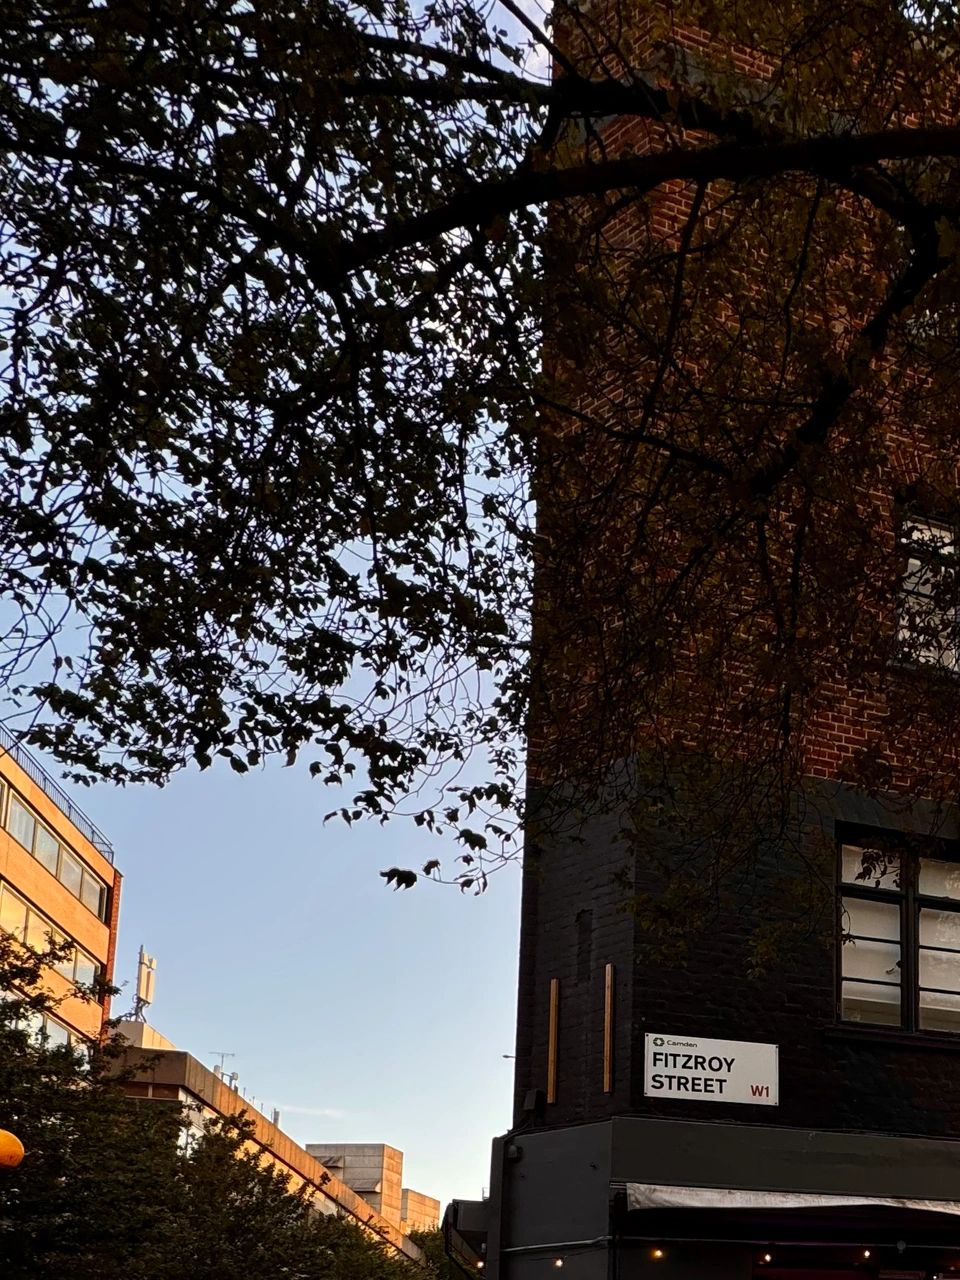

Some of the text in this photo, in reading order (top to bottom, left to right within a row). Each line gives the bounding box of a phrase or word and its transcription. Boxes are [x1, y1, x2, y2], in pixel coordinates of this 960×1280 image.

[667, 1039, 698, 1048] Camden
[653, 1052, 735, 1072] FITZROY
[651, 1074, 770, 1098] STREET W1
